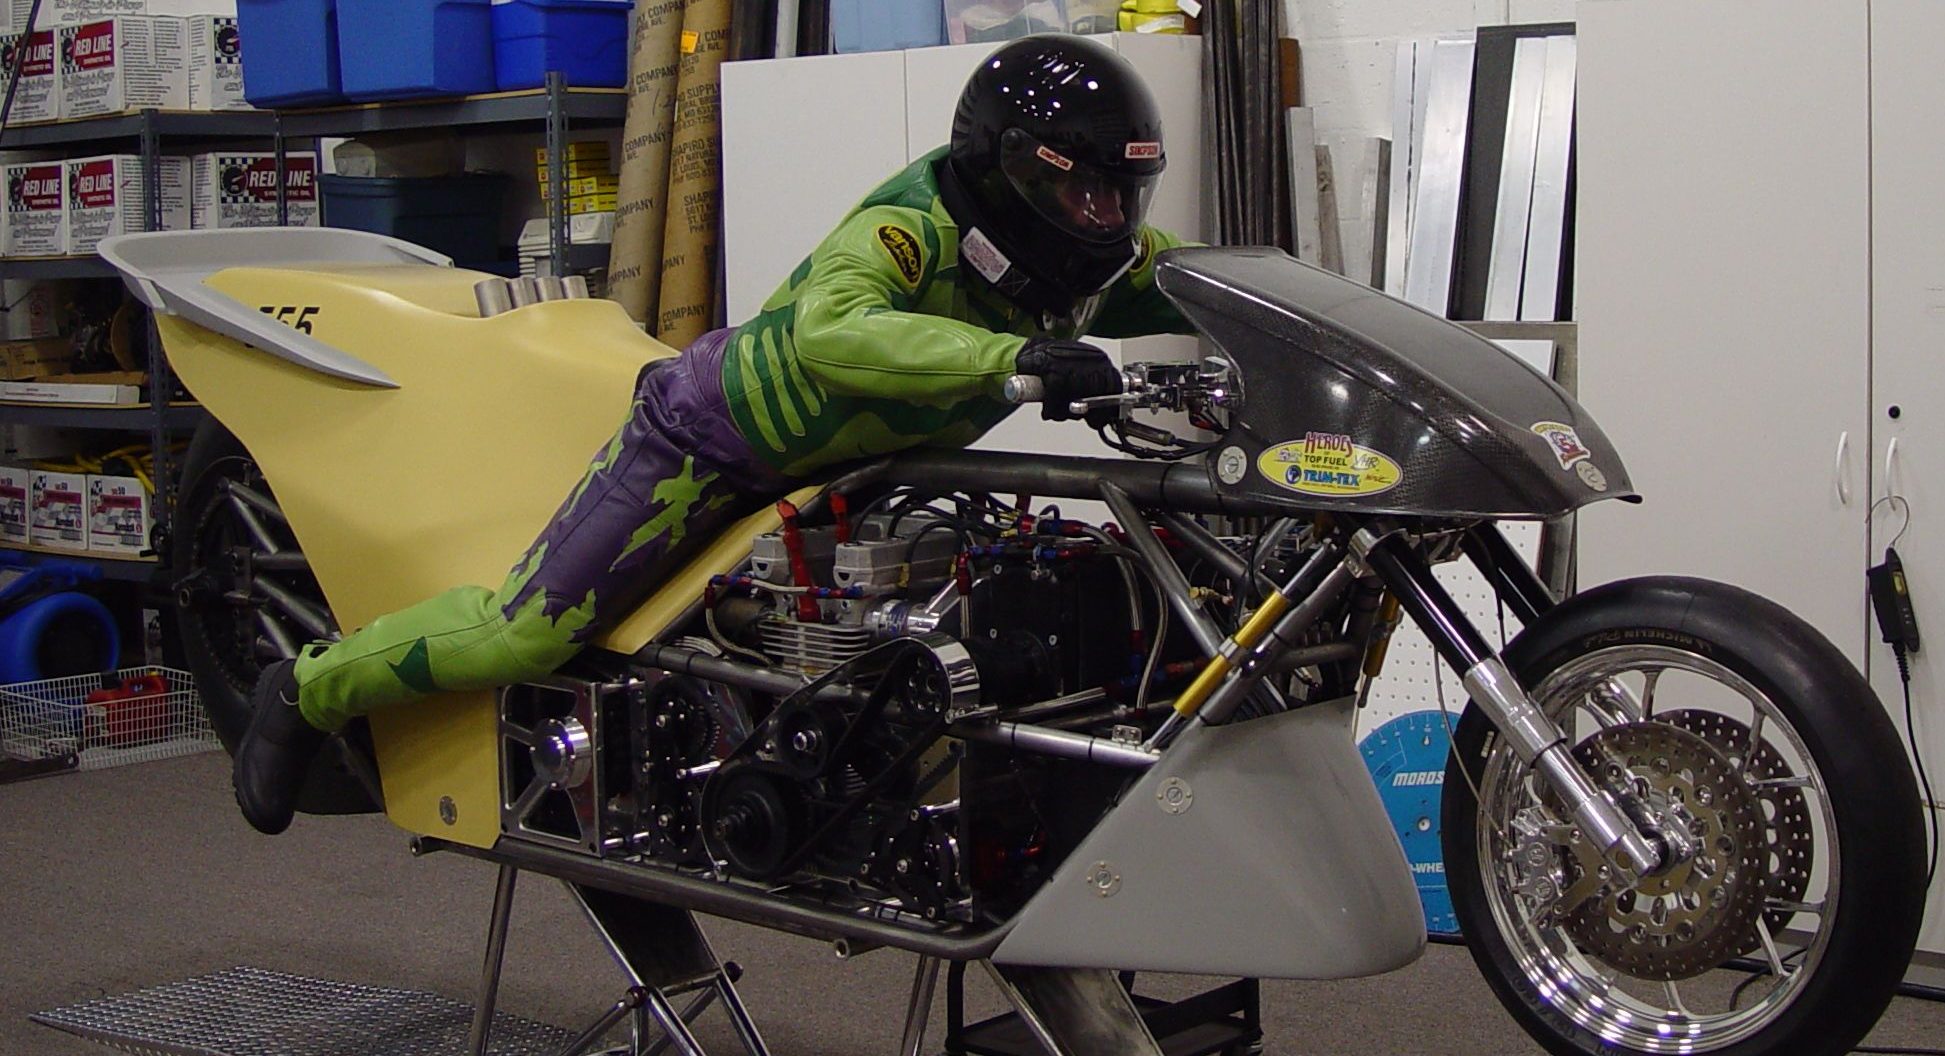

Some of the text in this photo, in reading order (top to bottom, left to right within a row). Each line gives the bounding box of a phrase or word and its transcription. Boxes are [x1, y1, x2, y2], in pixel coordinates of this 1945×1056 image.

[33, 43, 53, 61] LINE
[75, 34, 112, 56] RED LINE
[624, 130, 667, 153] COMPANY
[23, 178, 60, 196] RED LINE
[80, 173, 112, 193] RED LINE
[249, 170, 311, 188] RED INE
[663, 254, 686, 273] PANY
[662, 304, 705, 324] COMPANY
[1304, 454, 1321, 464] TOP
[1323, 456, 1347, 467] FUEL
[1303, 469, 1360, 487] TRIM-TEX
[1623, 629, 1693, 645] MICHELIN
[1392, 770, 1446, 787] MOROS
